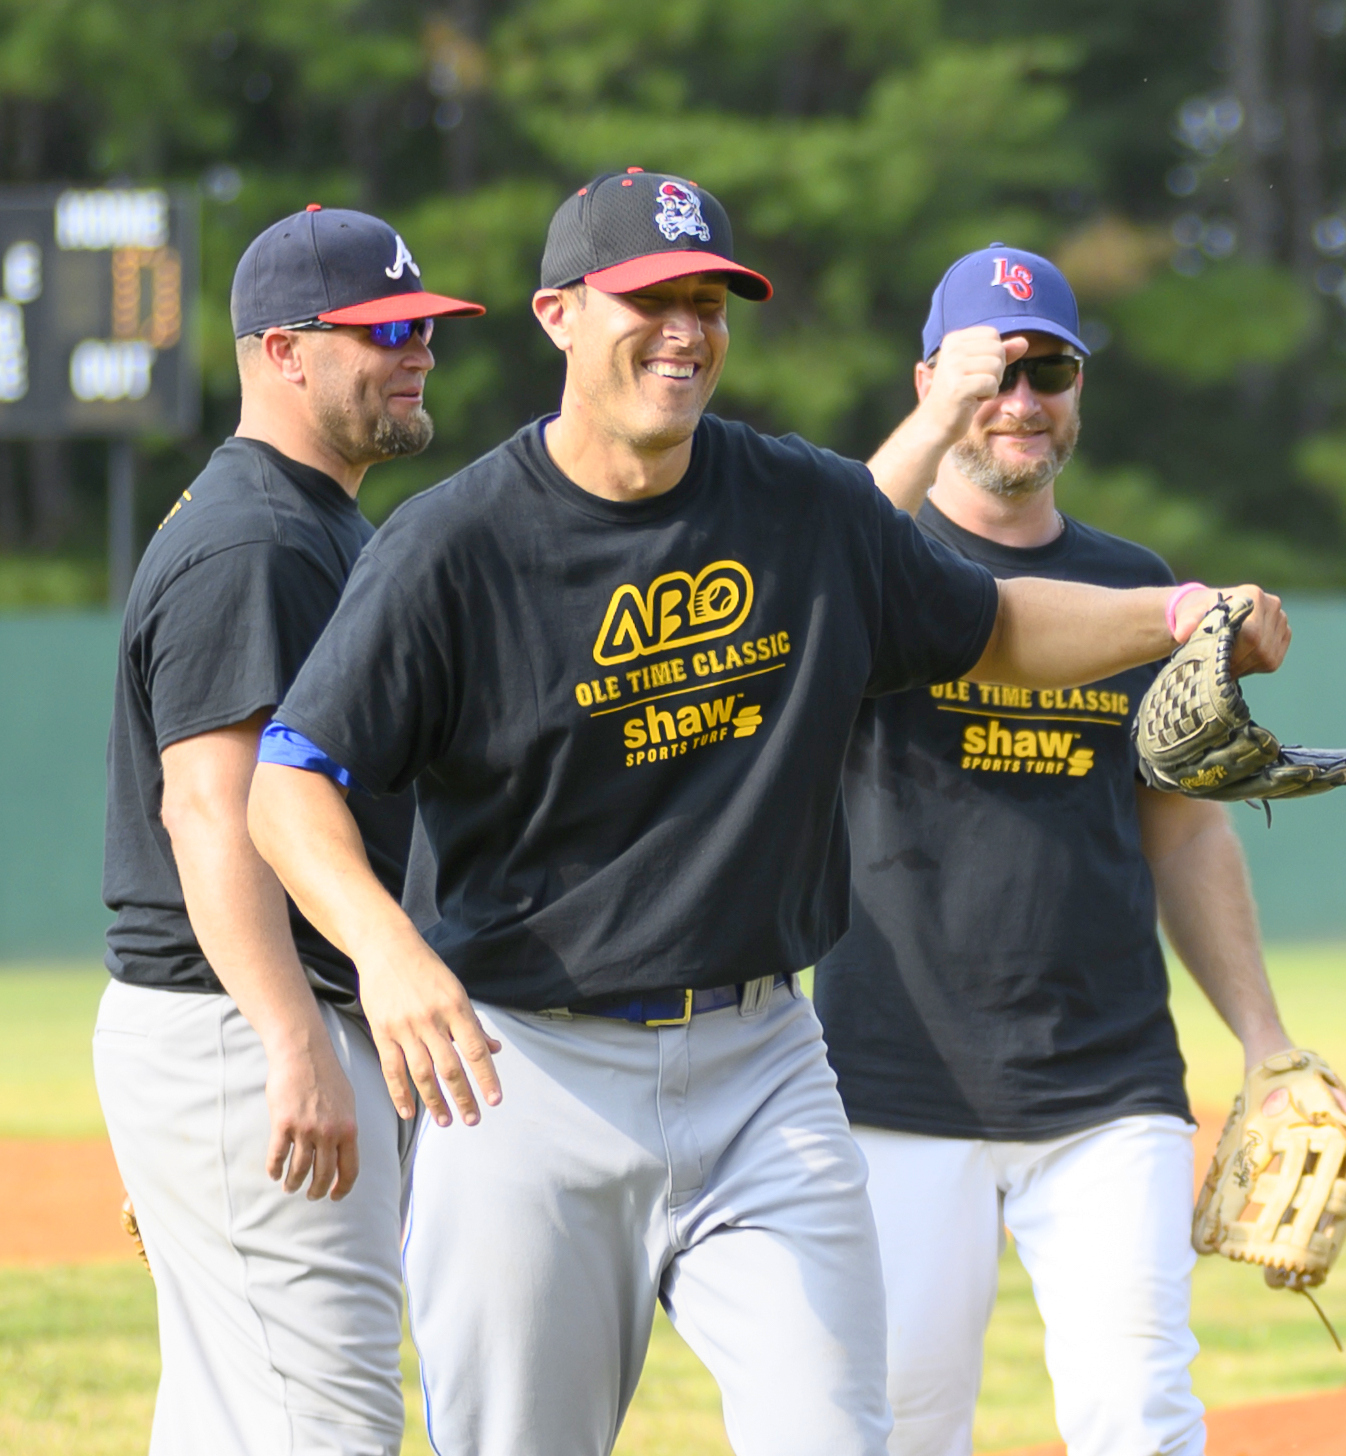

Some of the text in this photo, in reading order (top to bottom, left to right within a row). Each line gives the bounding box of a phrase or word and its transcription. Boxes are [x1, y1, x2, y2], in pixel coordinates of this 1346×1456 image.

[385, 234, 420, 280] A
[990, 258, 1034, 301] LS
[70, 339, 153, 400] OUT
[574, 631, 791, 707] OLE TIME CLASSIC
[930, 681, 1129, 716] OLE TIME CLASSIC
[624, 695, 736, 749] shaw
[962, 720, 1073, 759] shaw
[625, 728, 728, 767] SPORTS TURF
[961, 756, 1065, 775] SPORTS TURF
